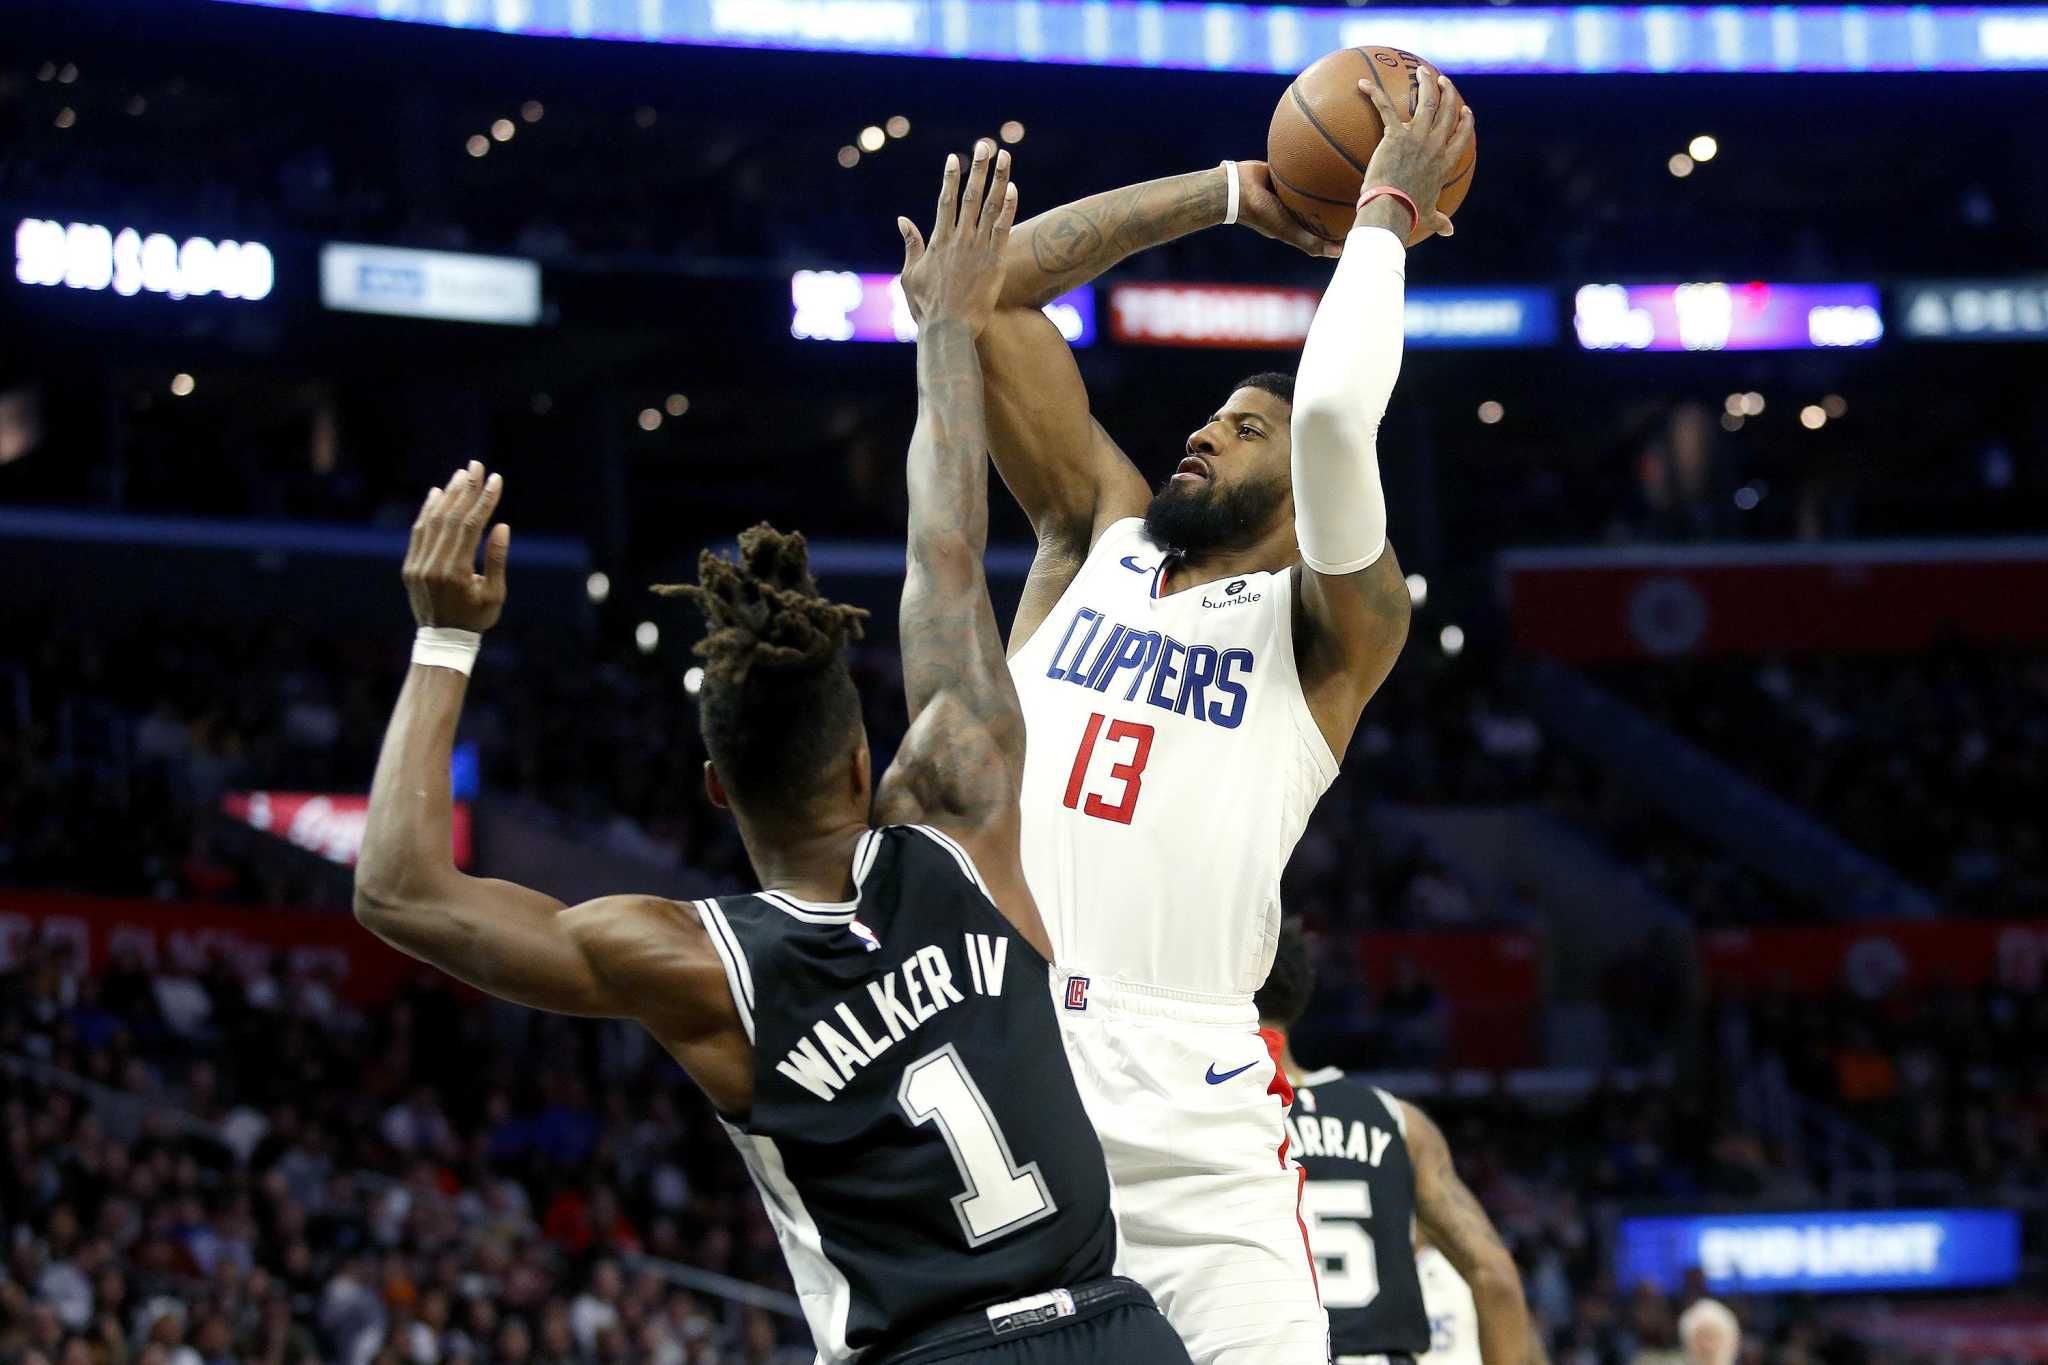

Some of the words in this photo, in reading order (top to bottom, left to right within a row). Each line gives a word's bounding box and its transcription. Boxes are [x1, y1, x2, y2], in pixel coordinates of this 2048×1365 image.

[1202, 592, 1261, 608] bumble
[1046, 607, 1254, 729] CLIPPERS
[1063, 712, 1155, 825] 13
[776, 944, 964, 1101] WALKER
[965, 933, 1008, 996] IV
[898, 1042, 1058, 1248] 1
